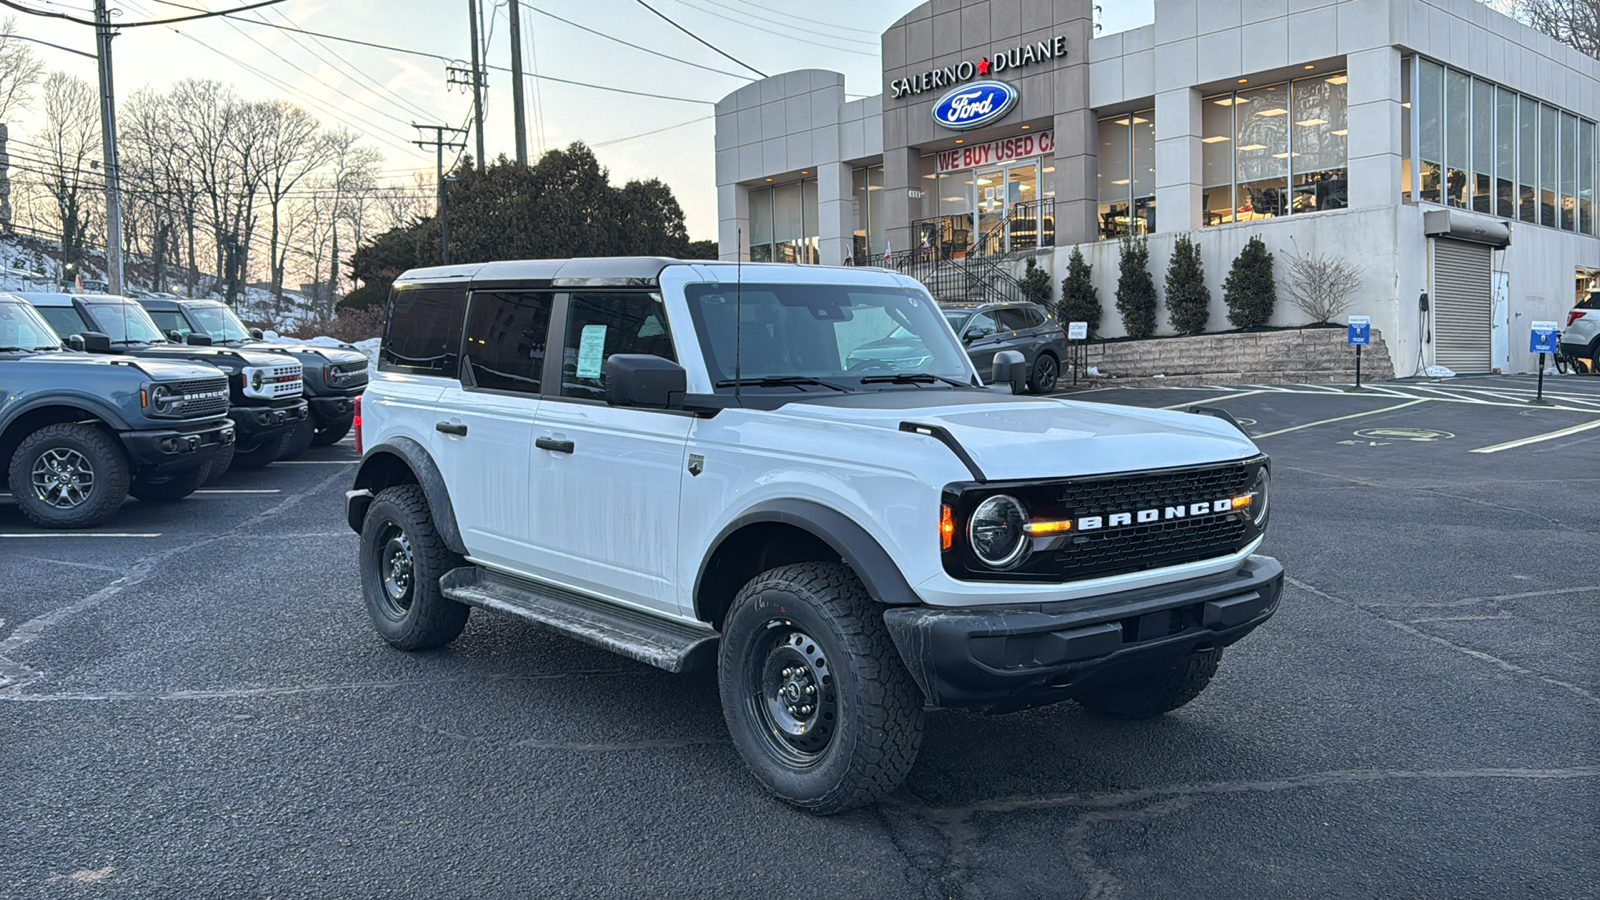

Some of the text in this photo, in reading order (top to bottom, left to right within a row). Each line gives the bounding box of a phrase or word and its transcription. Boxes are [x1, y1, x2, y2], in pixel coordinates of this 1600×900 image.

[891, 35, 1066, 98] SALERNO DUANE
[947, 91, 993, 121] Ford
[938, 149, 960, 171] WE
[963, 144, 991, 165] BUY
[996, 136, 1034, 160] USED
[1078, 499, 1232, 530] BRONCO
